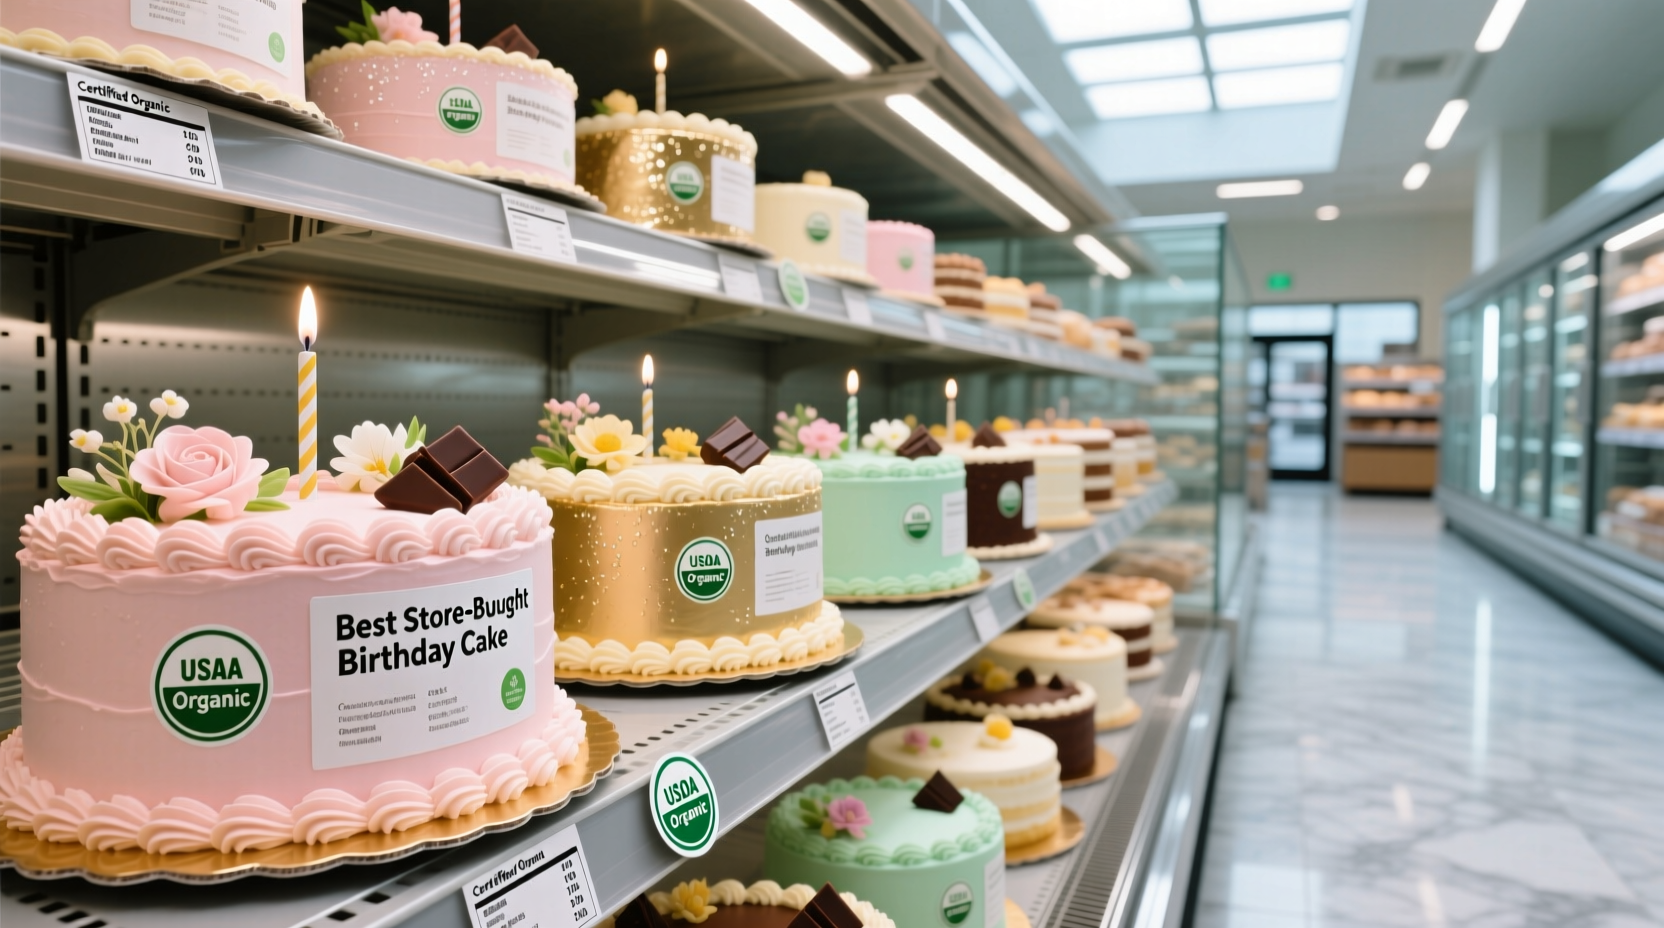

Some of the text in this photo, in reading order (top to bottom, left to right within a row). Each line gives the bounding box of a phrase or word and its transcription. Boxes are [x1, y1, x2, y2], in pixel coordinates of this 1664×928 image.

[336, 610, 398, 641] Best
[338, 625, 508, 677] Birthday Cake
[180, 657, 244, 682] USAA
[172, 687, 251, 714] Organic
[663, 775, 700, 806] USDA
[669, 800, 709, 829] Organic
